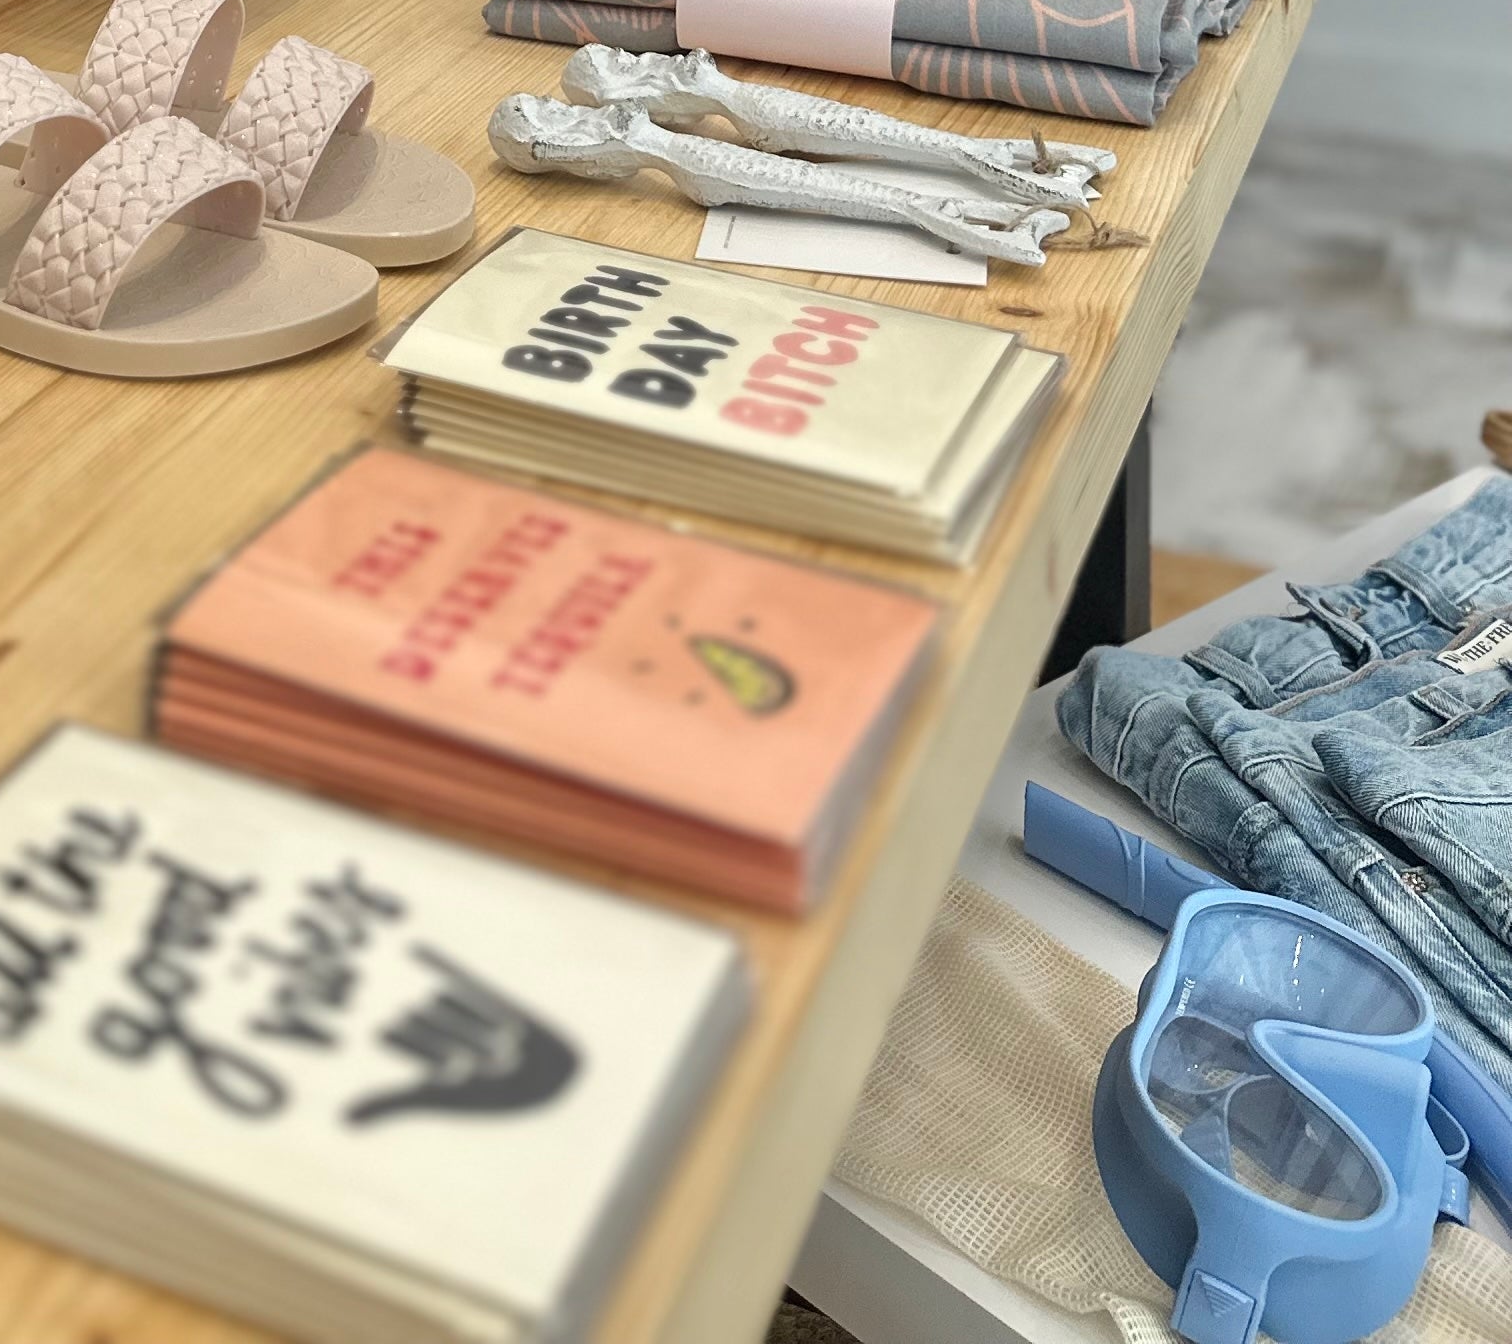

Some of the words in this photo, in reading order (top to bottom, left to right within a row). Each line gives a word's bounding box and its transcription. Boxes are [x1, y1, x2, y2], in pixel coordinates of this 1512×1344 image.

[501, 264, 671, 384] BIRTH
[607, 315, 740, 410] DAY
[718, 305, 881, 438] BITCH
[330, 518, 442, 601] THIS
[378, 511, 572, 686] DESERVES
[489, 550, 657, 700] TEQUILA
[1461, 640, 1493, 662] THE
[88, 848, 296, 1122] good
[233, 855, 408, 1052] vibes
